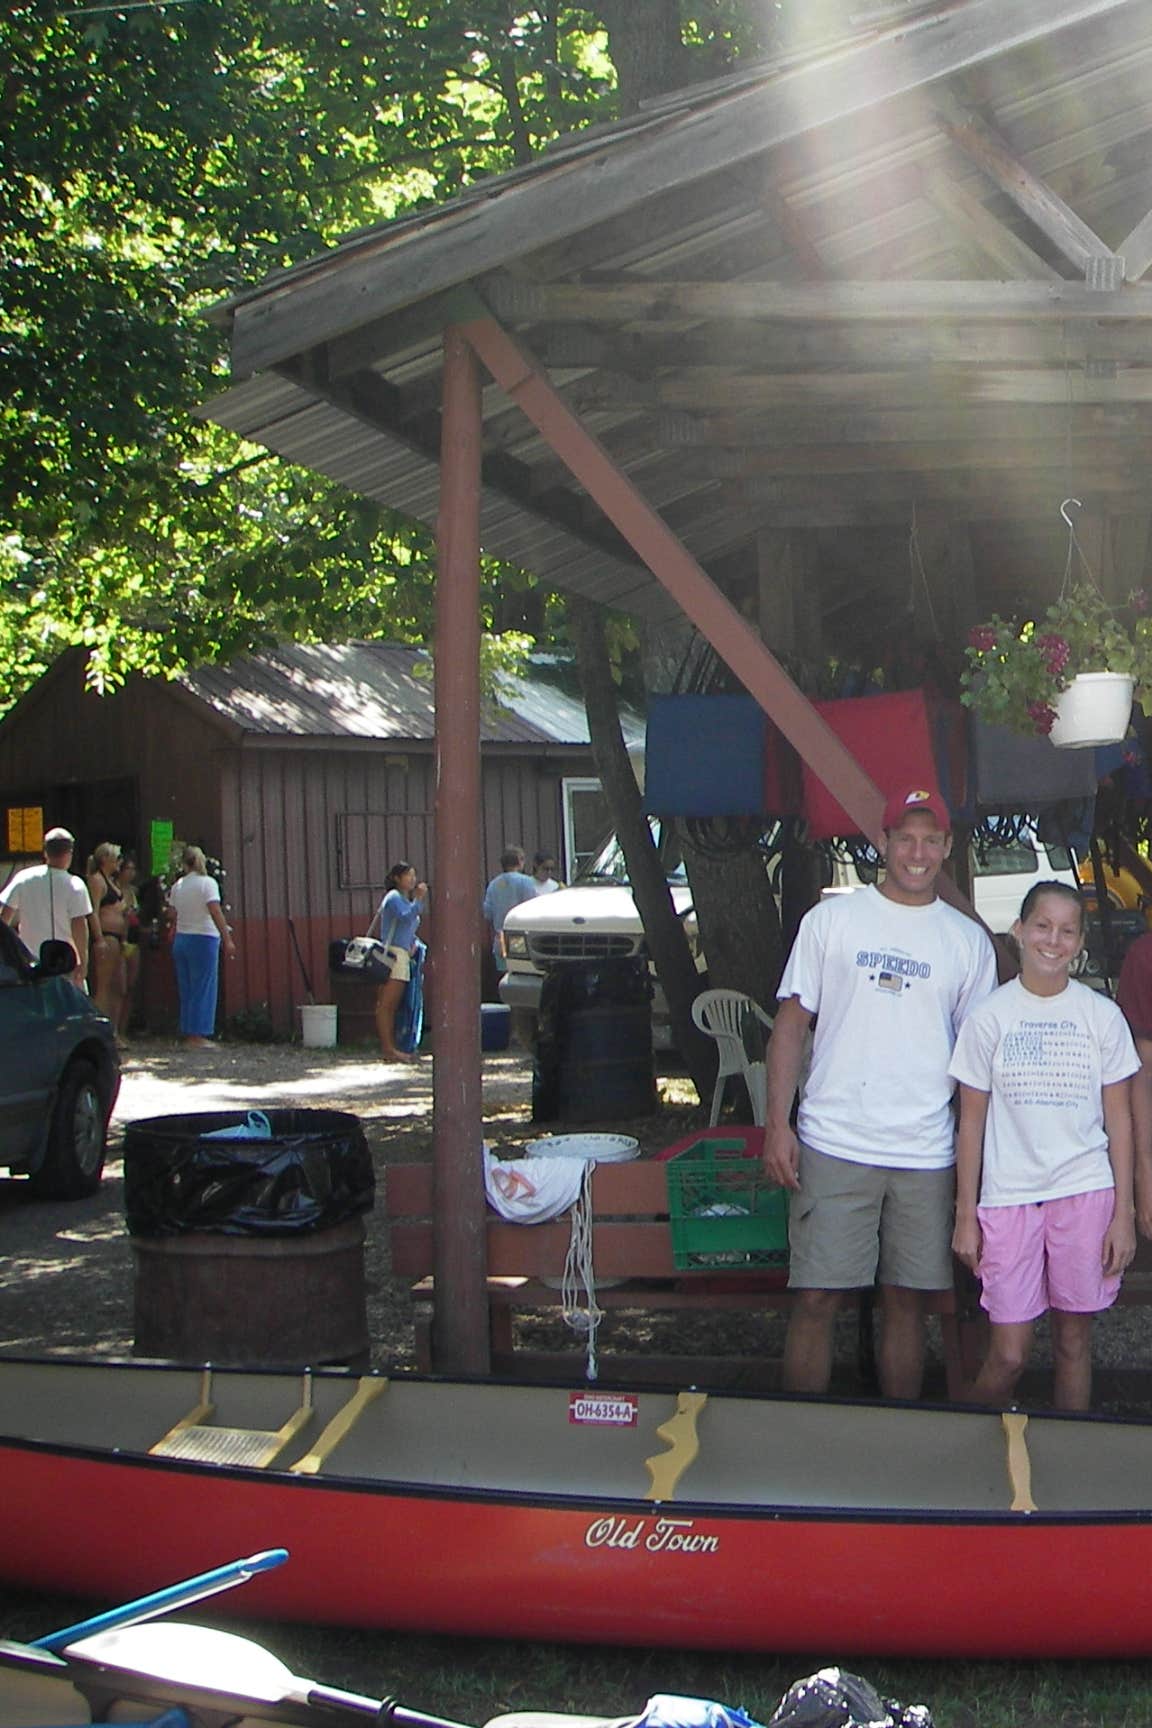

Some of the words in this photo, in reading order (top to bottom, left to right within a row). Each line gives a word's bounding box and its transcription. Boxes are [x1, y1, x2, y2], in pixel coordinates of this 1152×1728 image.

[856, 950, 931, 979] SPEEDO
[576, 1402, 631, 1420] OH-6354-A
[585, 1516, 645, 1549] Old
[645, 1517, 720, 1553] Town
